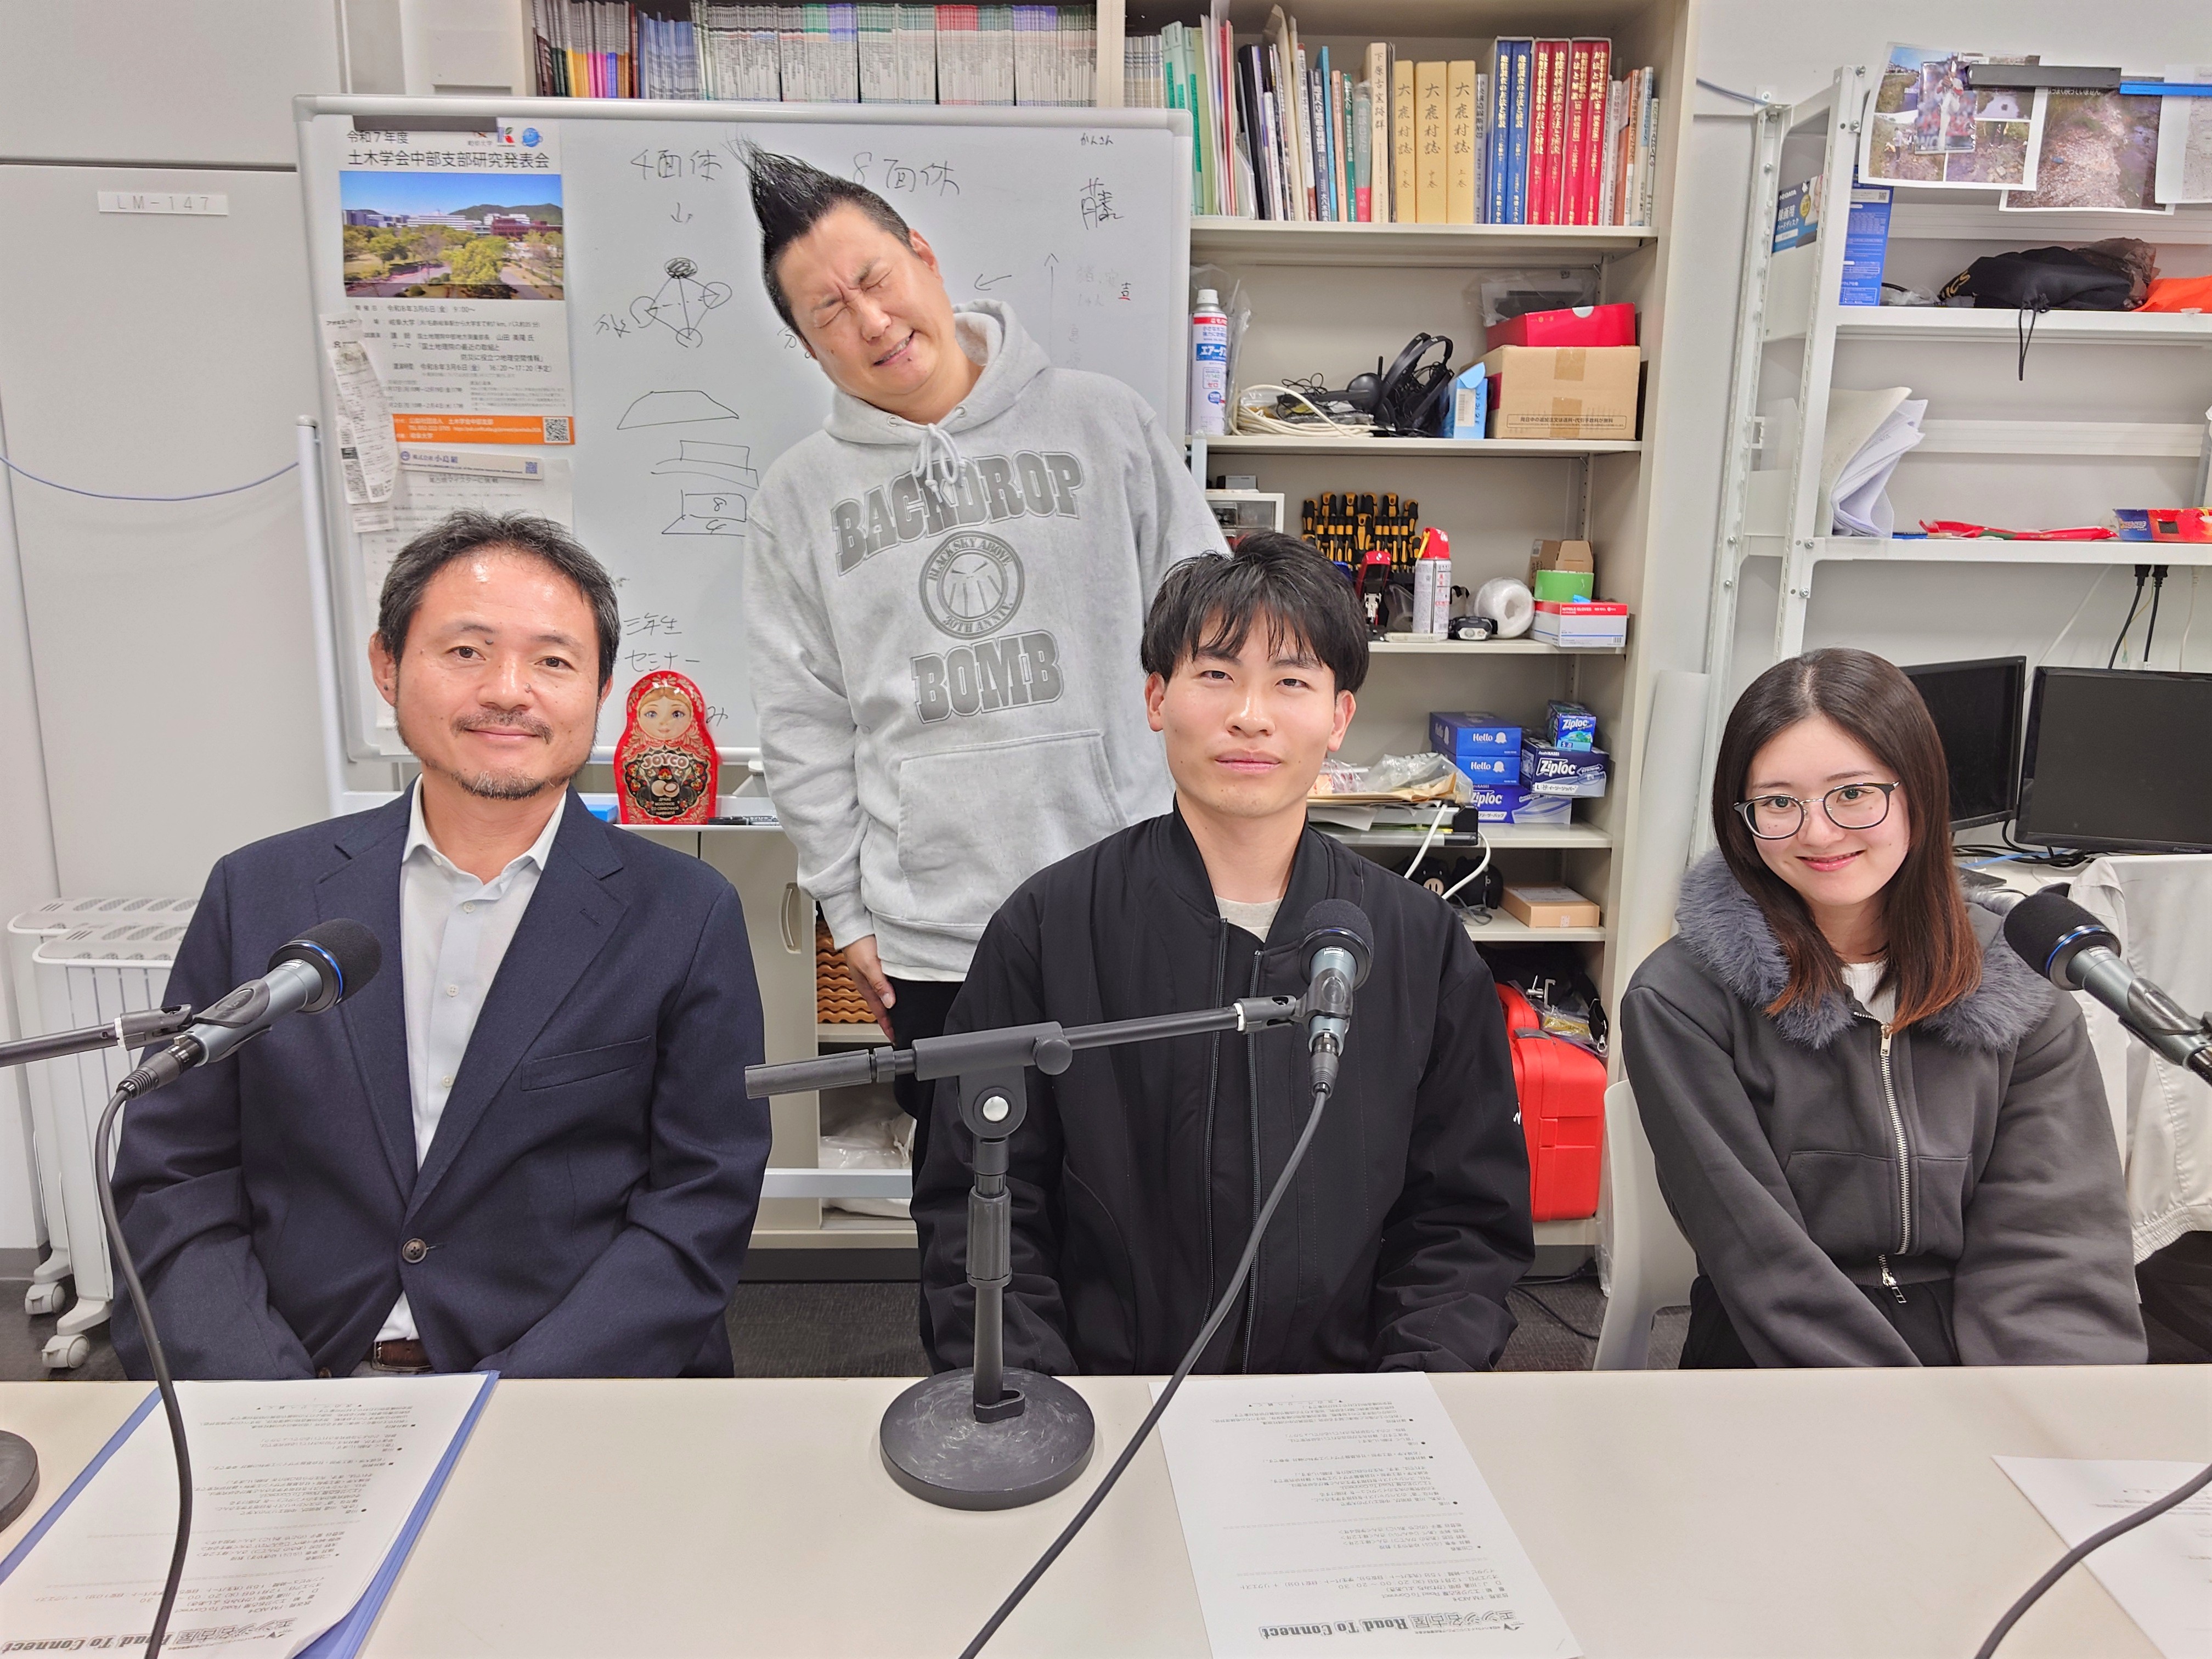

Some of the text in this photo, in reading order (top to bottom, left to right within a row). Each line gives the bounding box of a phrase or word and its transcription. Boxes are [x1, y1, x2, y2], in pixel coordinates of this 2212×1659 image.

[1398, 83, 1413, 155] 大鹿村誌
[1424, 83, 1441, 155] 大鹿村誌
[1454, 82, 1470, 154] 大鹿村誌
[347, 131, 409, 144] 令和7年度
[348, 150, 549, 169] 土木学会中部支部研究発表会
[117, 195, 208, 210] LM-147
[831, 450, 1086, 577] BACKDROP
[928, 538, 1013, 582] BLACK SKY ABOVE
[624, 649, 701, 672] セミナー
[910, 629, 1064, 724] BOMB
[1562, 718, 1588, 730] Ziploc
[1472, 733, 1493, 742] Hello
[641, 753, 689, 769] JOYCO
[1471, 761, 1491, 770] Hello
[1539, 760, 1576, 776] Ziploc
[1471, 793, 1503, 806] Ziploc
[174, 1620, 295, 1644] エンジ名古屋
[1261, 1610, 1517, 1639] エンジ名古屋 Road To Connect
[0, 1638, 88, 1655] Connect
[86, 1638, 116, 1649] To
